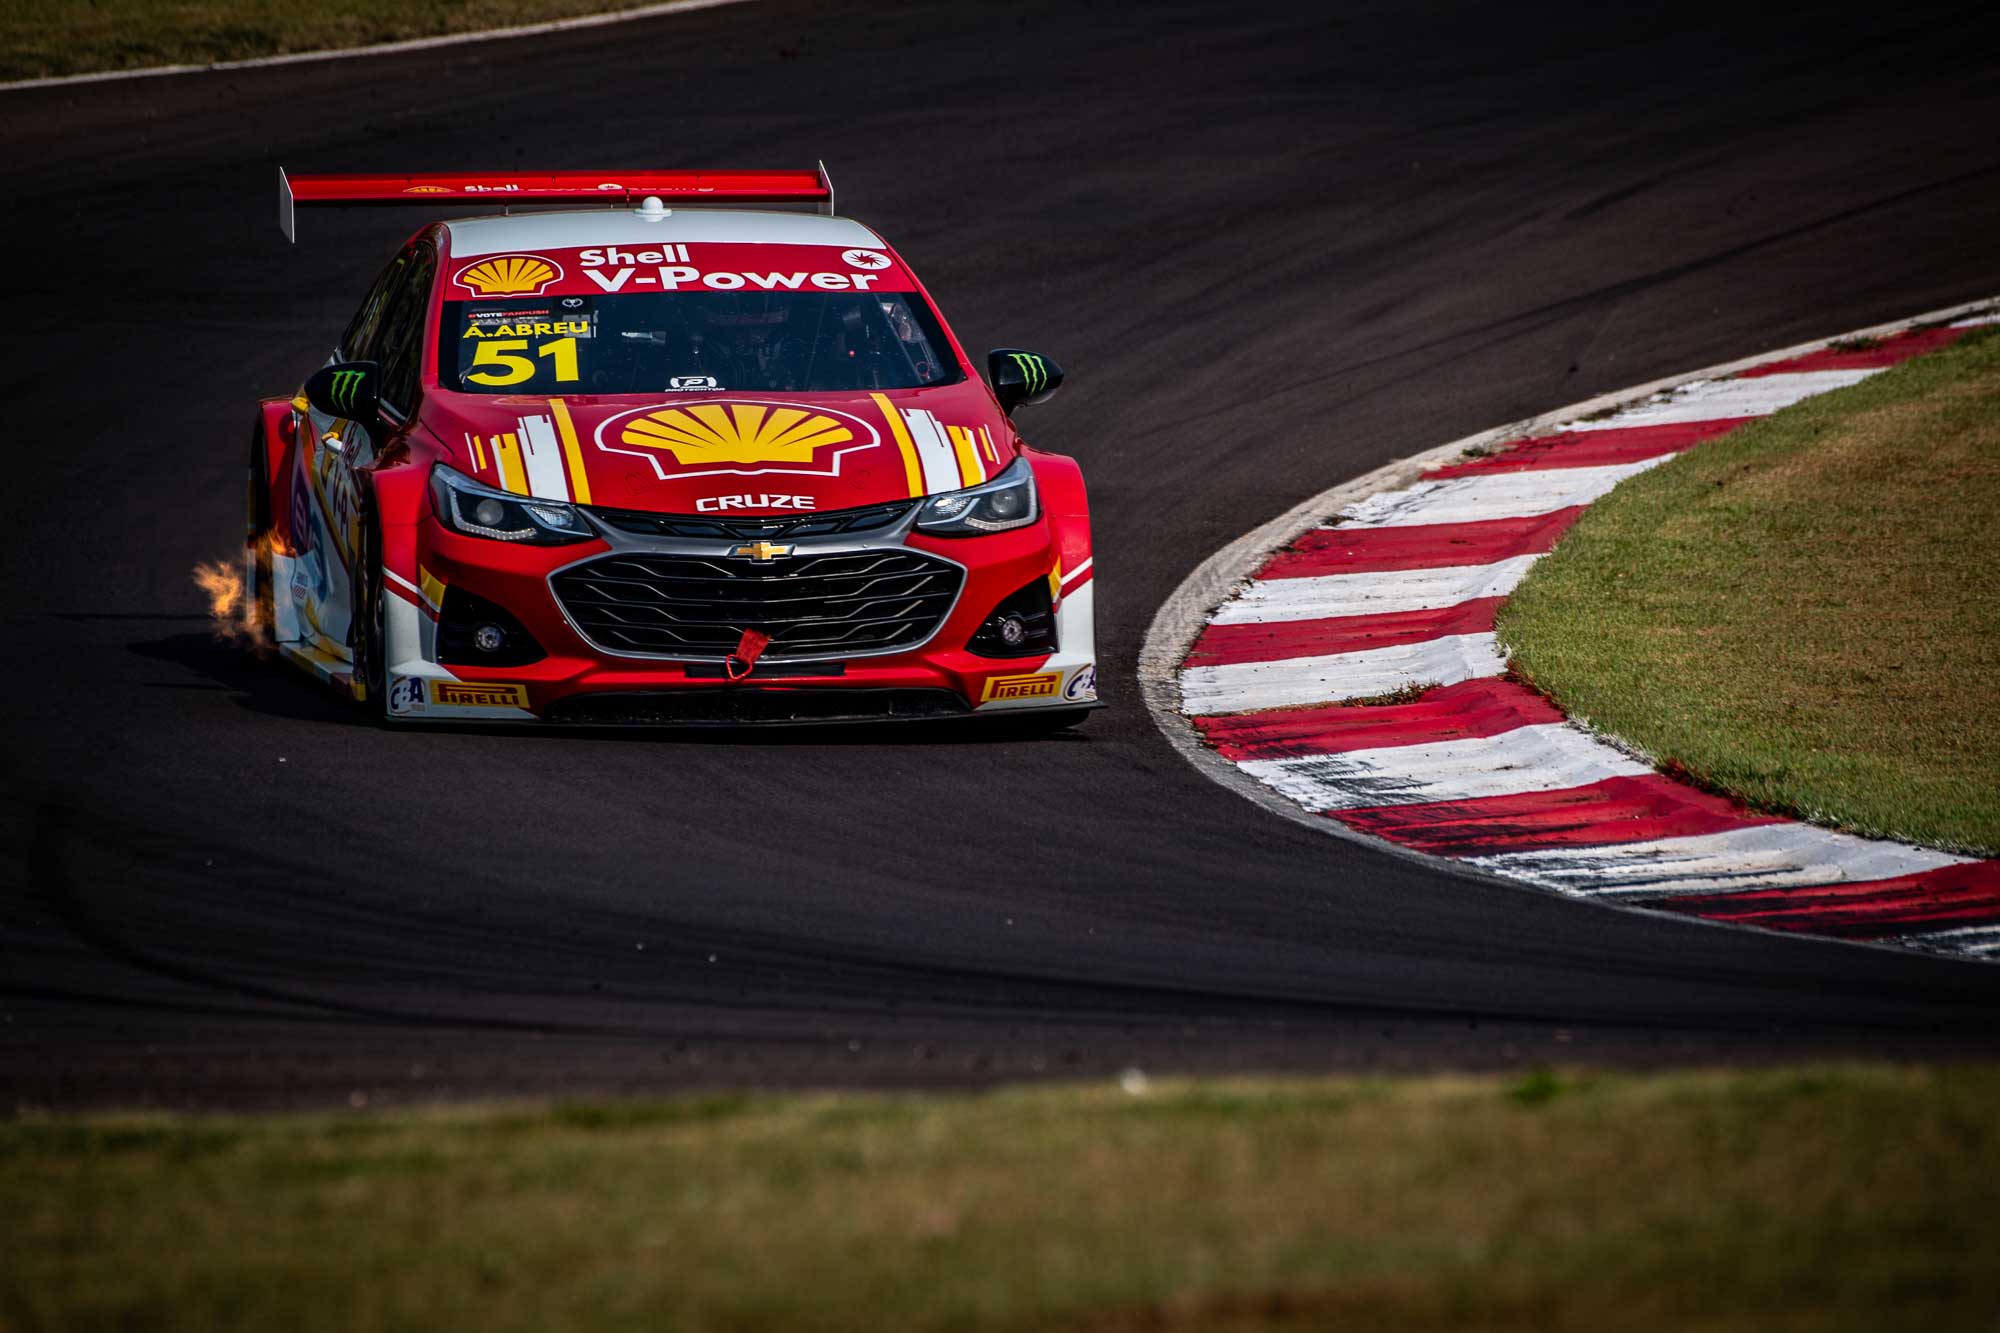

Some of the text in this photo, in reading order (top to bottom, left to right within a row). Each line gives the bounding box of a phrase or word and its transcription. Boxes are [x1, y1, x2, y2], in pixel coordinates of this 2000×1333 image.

[464, 184, 519, 192] Shell
[579, 244, 691, 266] Shell
[582, 266, 879, 293] V-Power
[467, 337, 579, 386] 51
[695, 494, 816, 512] CRUZE
[437, 683, 519, 705] PIRELLI
[989, 675, 1056, 698] PIRELLI
